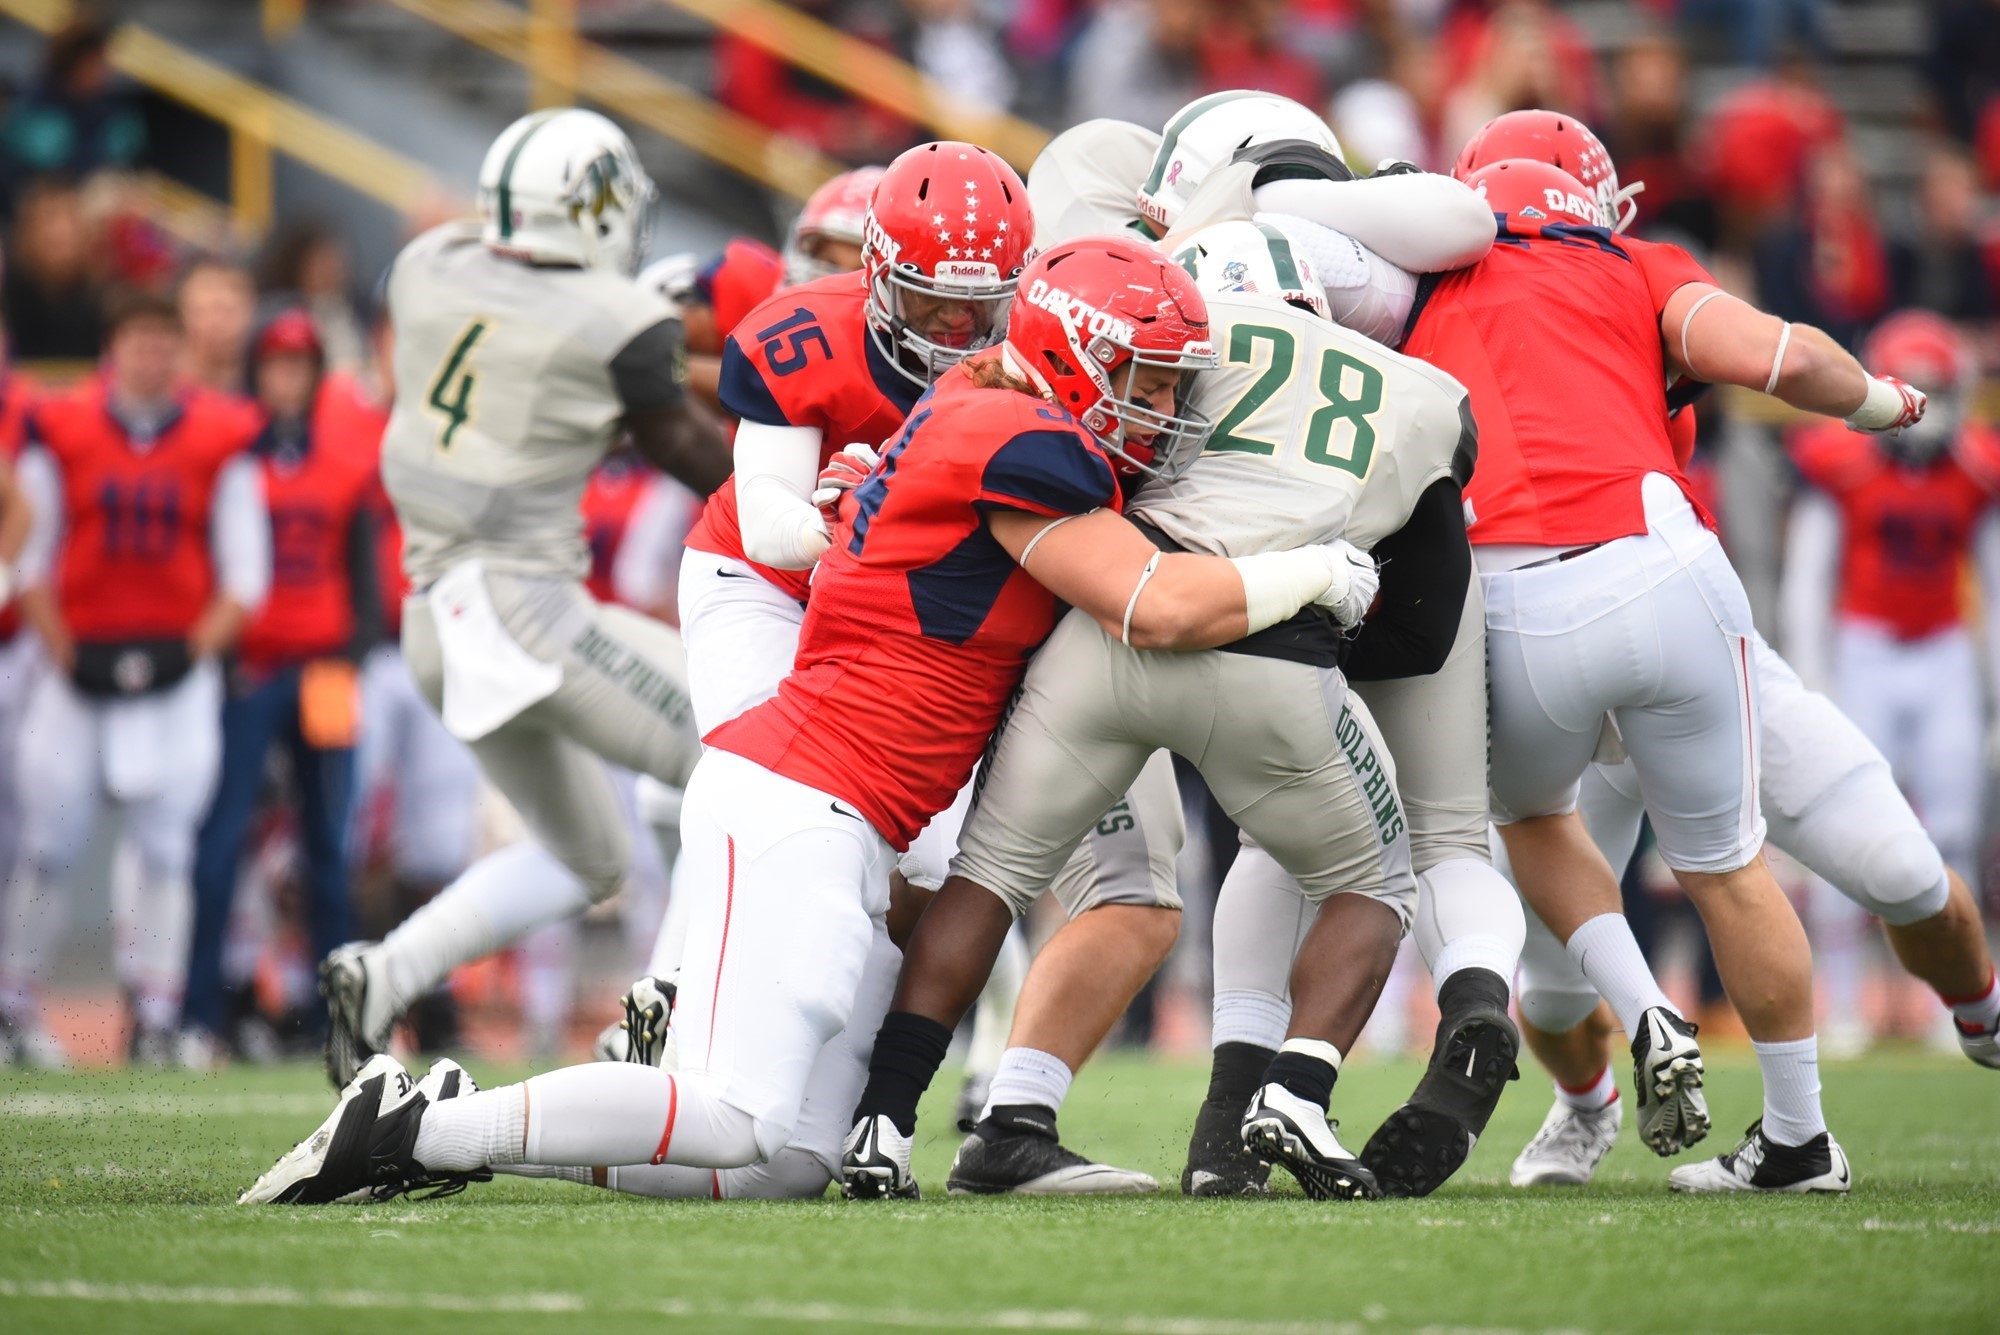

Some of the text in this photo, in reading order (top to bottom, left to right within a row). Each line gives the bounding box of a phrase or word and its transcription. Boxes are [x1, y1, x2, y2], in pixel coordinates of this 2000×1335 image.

[950, 265, 986, 276] Riddell
[1027, 278, 1136, 346] DAYTON
[426, 320, 490, 452] 4
[756, 307, 834, 377] 15
[1203, 321, 1385, 482] 28
[1335, 703, 1404, 846] DOLPHINS
